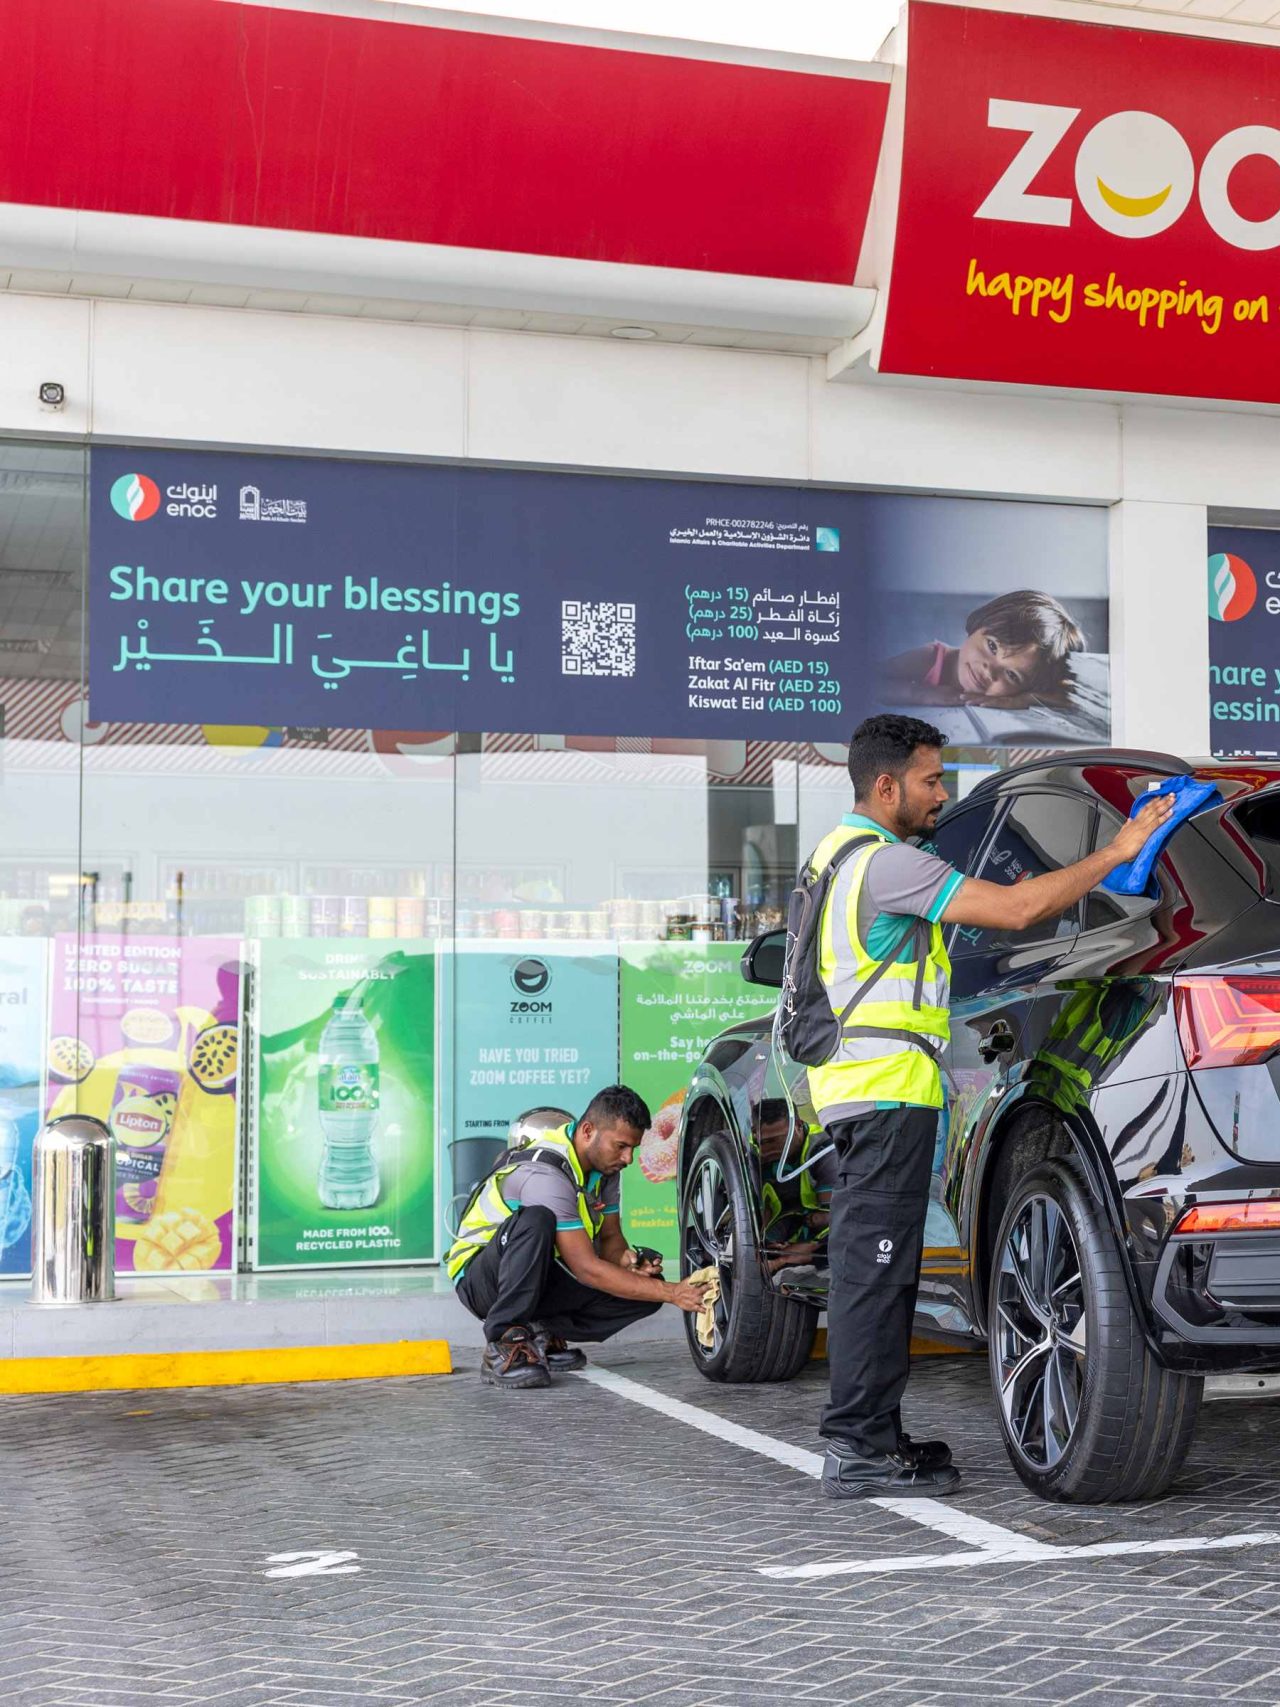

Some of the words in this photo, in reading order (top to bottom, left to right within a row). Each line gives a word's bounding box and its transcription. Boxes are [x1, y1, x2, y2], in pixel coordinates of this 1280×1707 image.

[966, 258, 1075, 323] happy
[1083, 272, 1225, 334] shopping
[1233, 299, 1269, 323] on
[166, 502, 217, 518] enoc
[109, 565, 229, 604] Share
[240, 578, 332, 615] your
[344, 576, 521, 624] blessings
[488, 632, 515, 684] يا
[688, 656, 720, 670] Iftar
[768, 660, 803, 674] (AED
[807, 661, 829, 676] 15)
[1210, 665, 1266, 686] hare
[688, 675, 730, 690] Zakat
[733, 677, 747, 690] Al
[752, 678, 776, 691] Fitr
[779, 679, 813, 694] (AED
[818, 681, 840, 695] 25)
[688, 694, 739, 709] Kiswat
[742, 697, 764, 710] Eid
[768, 698, 804, 712] (AED
[809, 699, 841, 714] 100)
[65, 944, 121, 957] LIMITED
[124, 945, 181, 958] EDITION
[65, 959, 112, 973] ZERO
[117, 960, 178, 975] SUGAR
[298, 969, 396, 980] SUSTAINABLY
[683, 960, 732, 973] ZOOM
[64, 977, 116, 992] 100%
[121, 978, 178, 994] TASTE
[510, 1001, 552, 1012] ZOOM
[670, 1036, 694, 1050] Say
[480, 1047, 512, 1063] HAVE
[515, 1047, 540, 1063] YOU
[544, 1047, 579, 1063] TRIED
[470, 1069, 505, 1085] ZOOM
[509, 1069, 556, 1085] COFFEE
[559, 1067, 591, 1084] YET?
[121, 1114, 159, 1129] Lipton
[465, 1119, 492, 1128] STARTING
[493, 1119, 510, 1127] FROM
[303, 1230, 334, 1239] MADE
[336, 1228, 366, 1238] FROM
[296, 1241, 353, 1251] RECYCLED
[355, 1238, 401, 1248] PLASTIC
